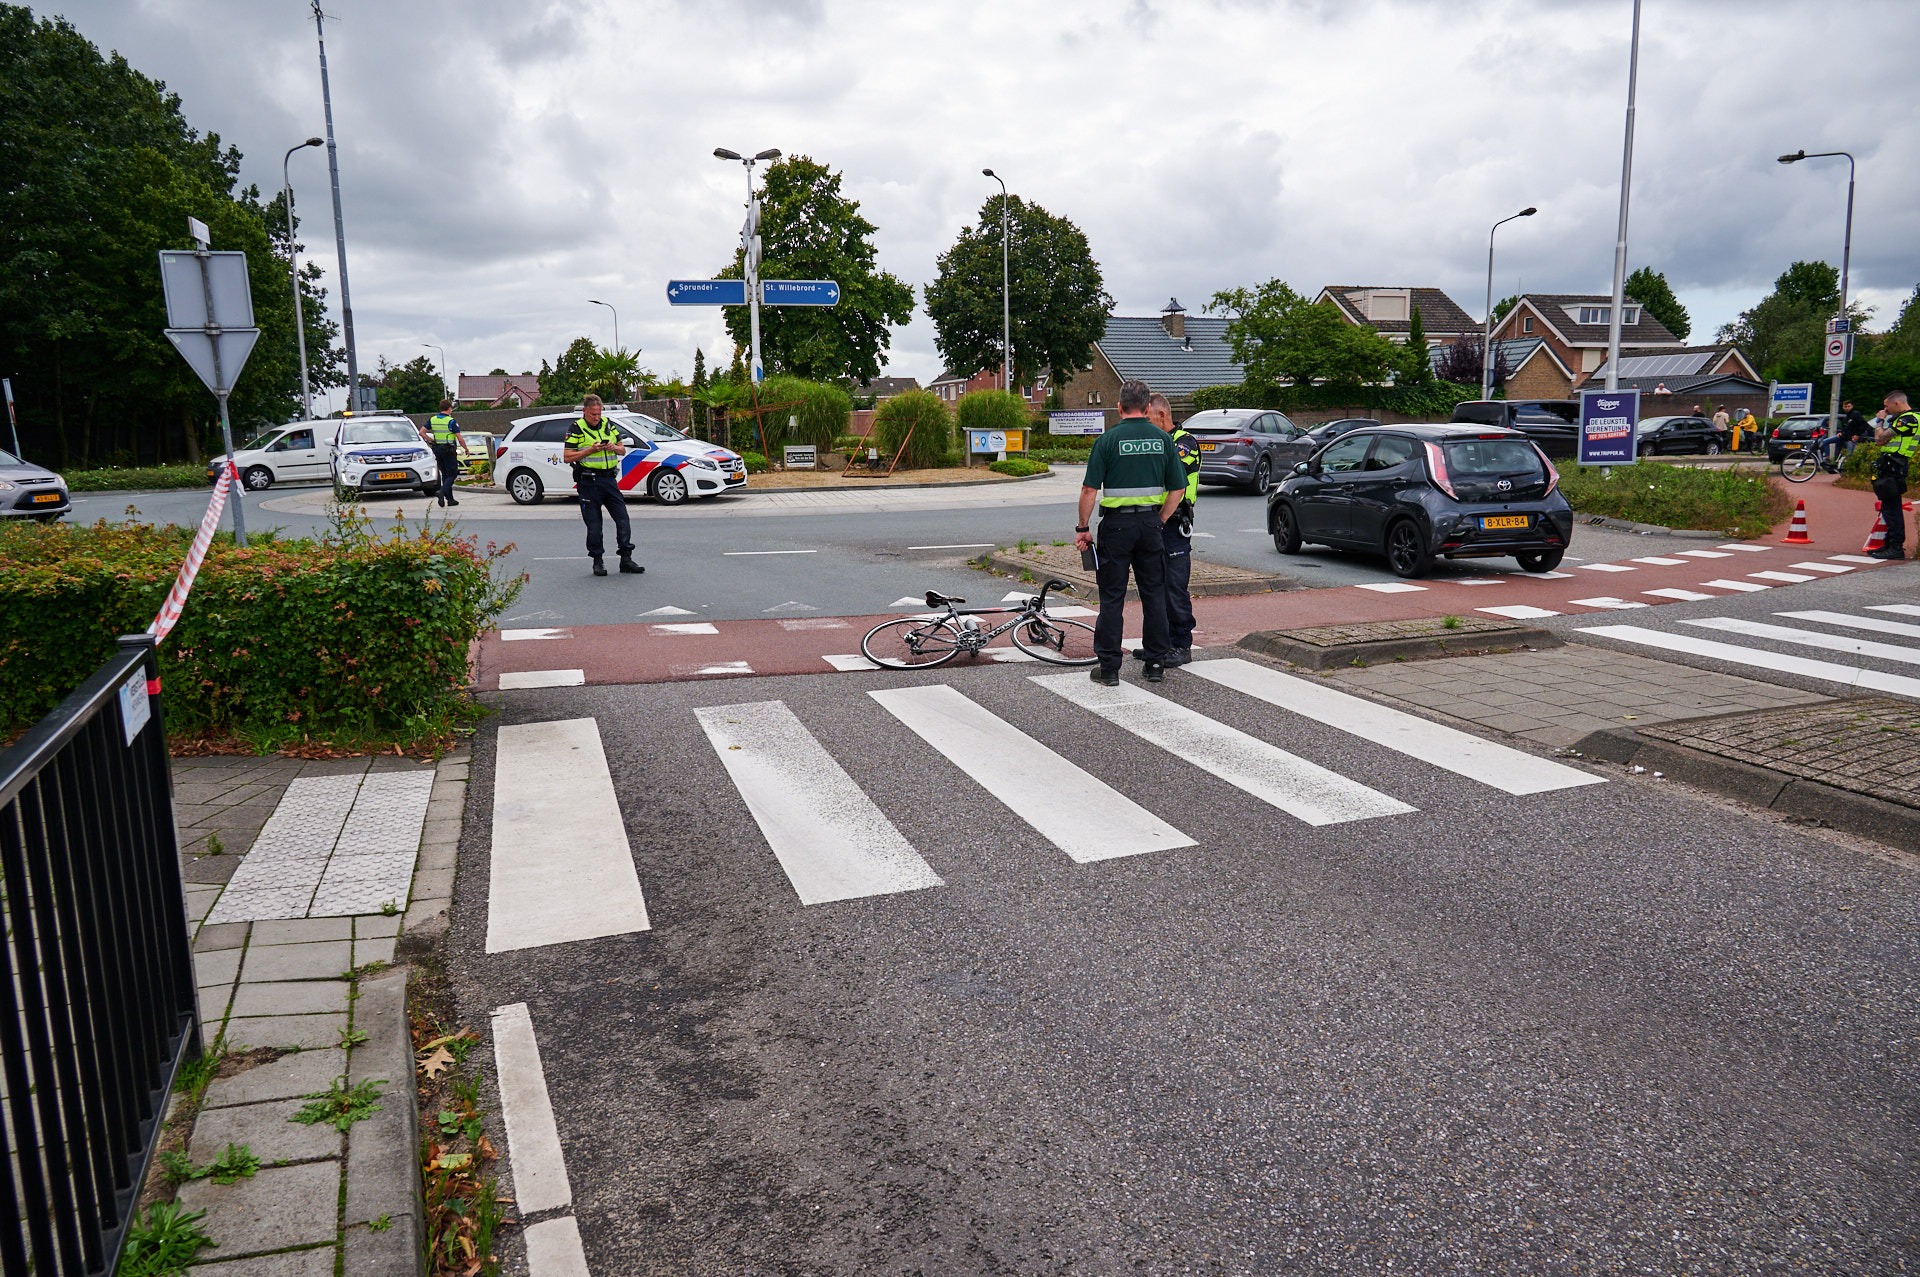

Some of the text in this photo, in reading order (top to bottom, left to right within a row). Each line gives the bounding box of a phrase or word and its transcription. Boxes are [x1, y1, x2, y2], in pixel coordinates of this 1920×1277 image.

[779, 284, 816, 292] Willebrord
[1597, 399, 1620, 408] tripper
[1586, 425, 1630, 433] DIERENTUINEN
[1121, 441, 1163, 453] OvDG
[1487, 517, 1525, 528] 8-XLR-84
